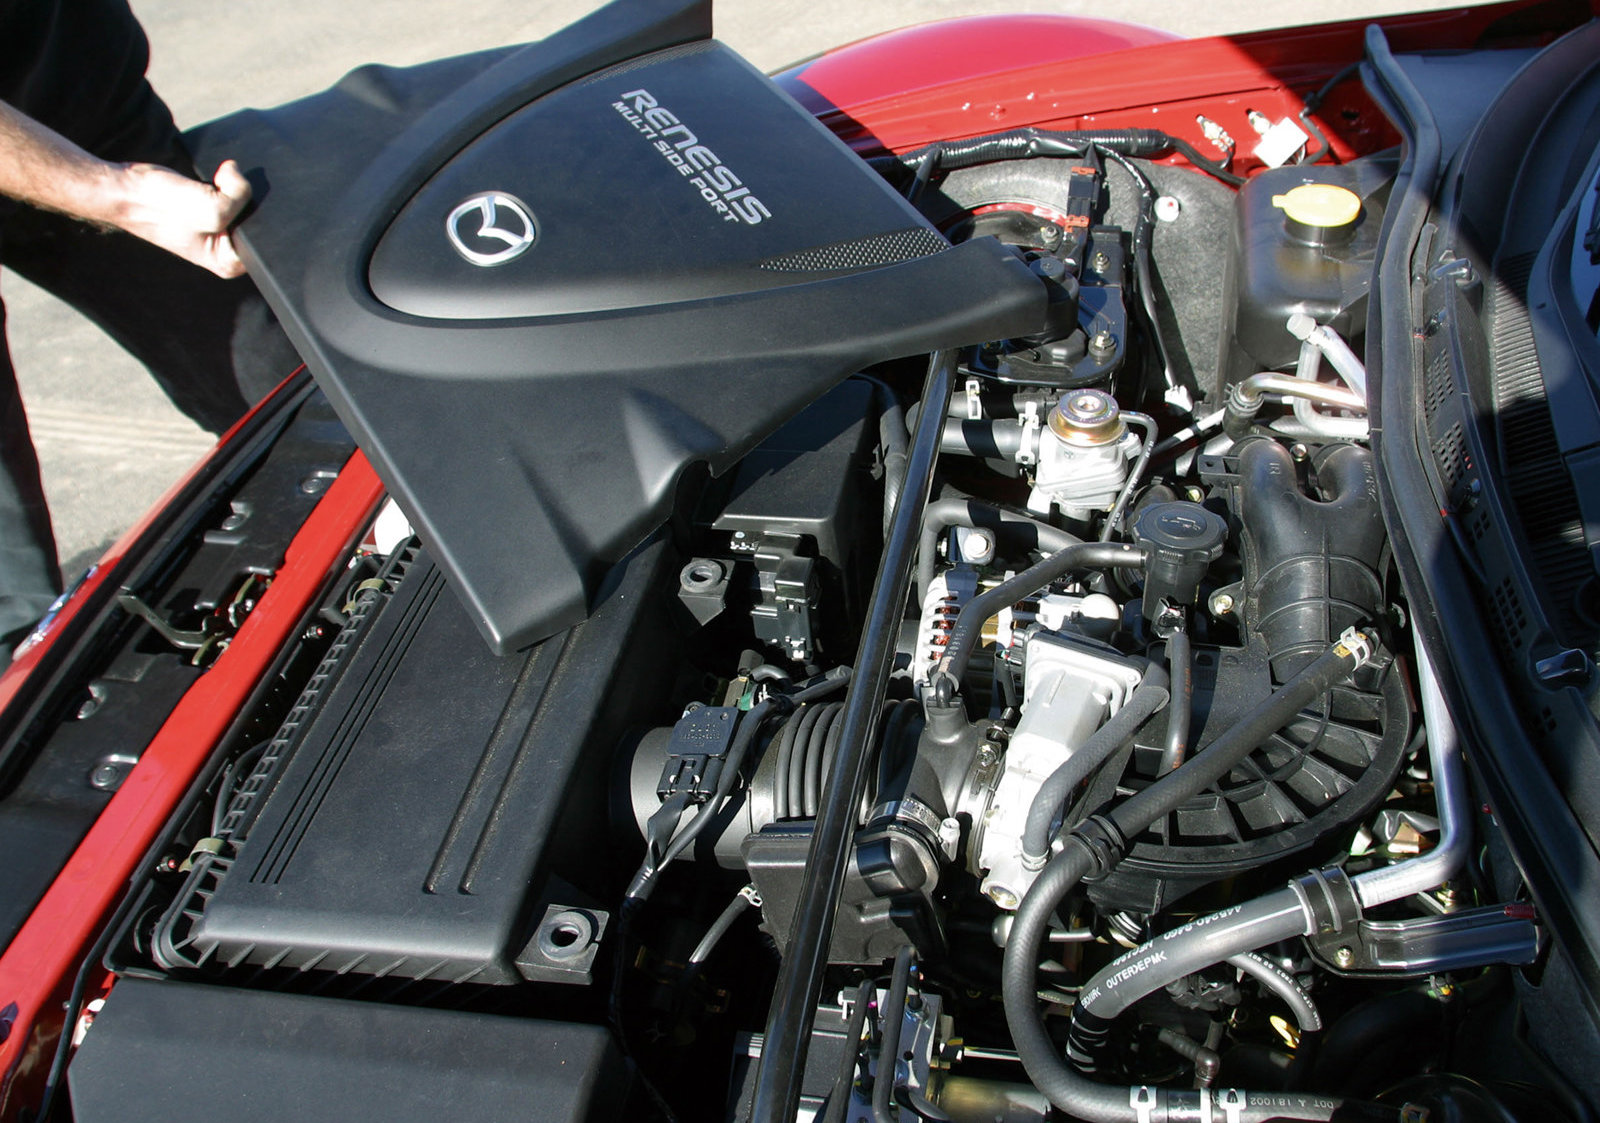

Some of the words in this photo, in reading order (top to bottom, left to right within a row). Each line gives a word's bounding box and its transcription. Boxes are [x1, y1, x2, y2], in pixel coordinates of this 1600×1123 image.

[611, 101, 658, 140] MULTI
[653, 139, 694, 176] SIDE
[690, 176, 739, 223] PORT
[620, 88, 772, 225] RENESIS
